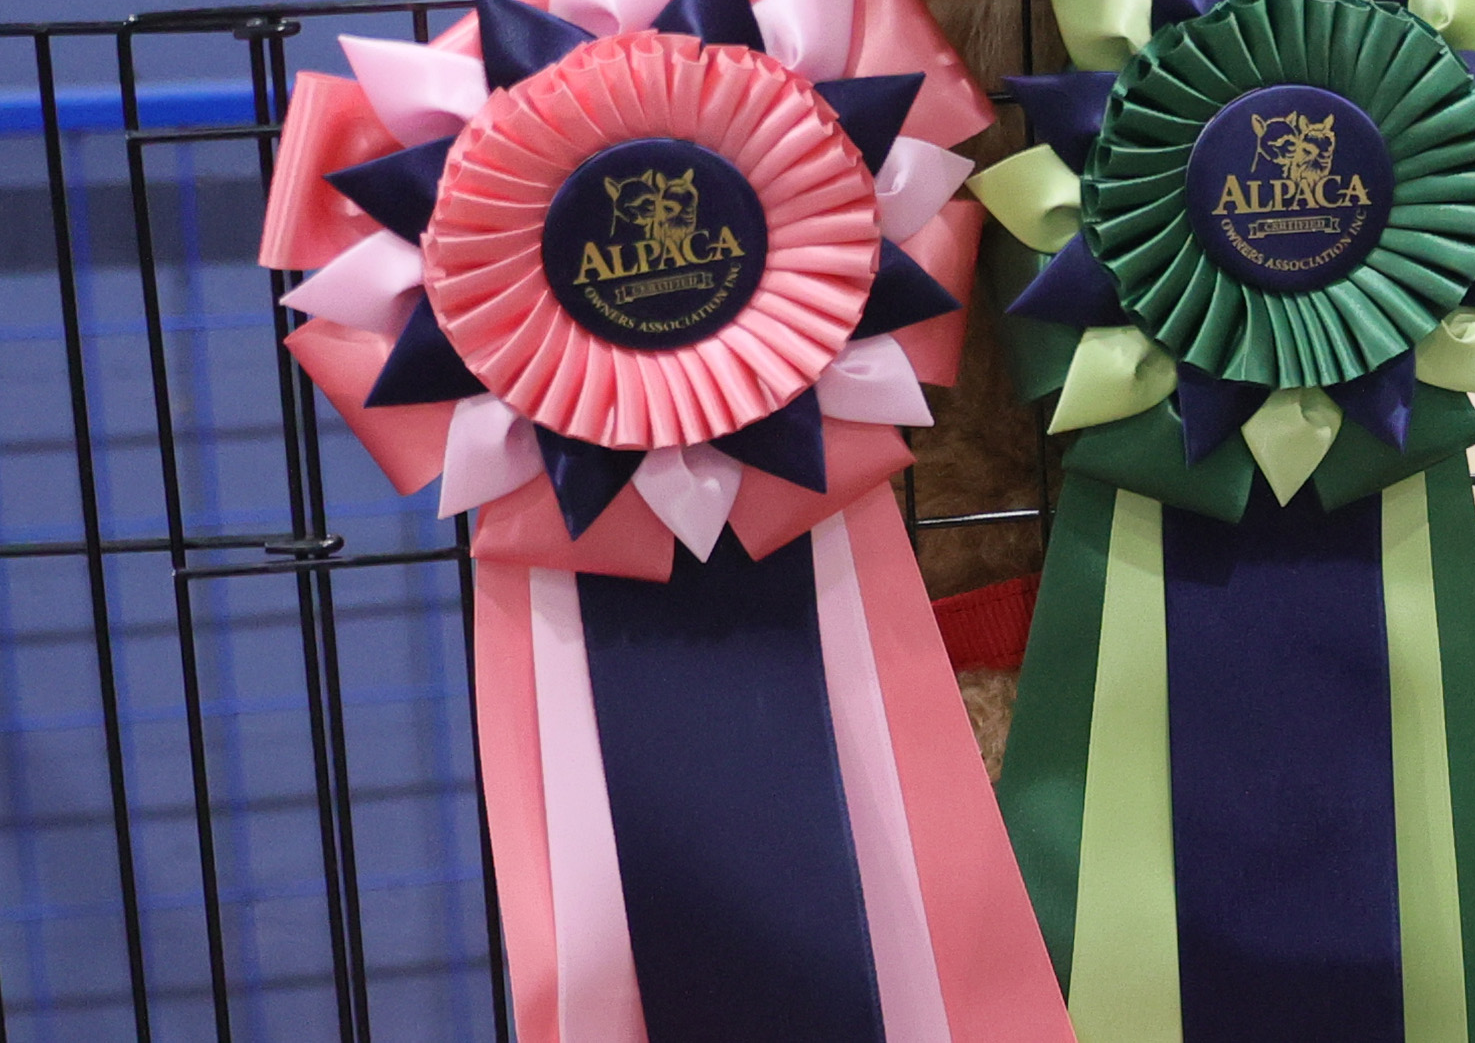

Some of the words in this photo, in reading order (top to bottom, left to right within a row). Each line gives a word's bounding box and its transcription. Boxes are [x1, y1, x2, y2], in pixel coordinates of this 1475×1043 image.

[1212, 174, 1372, 215] ALPACA
[1221, 218, 1264, 265] OWNERS
[1265, 238, 1351, 271] ASSOCIATION
[1350, 208, 1367, 235] INC
[1264, 220, 1326, 231] CERTIFIED
[573, 226, 746, 285] ALPACA
[584, 286, 634, 329] OWNERS
[640, 290, 729, 333] ASSOCIATION
